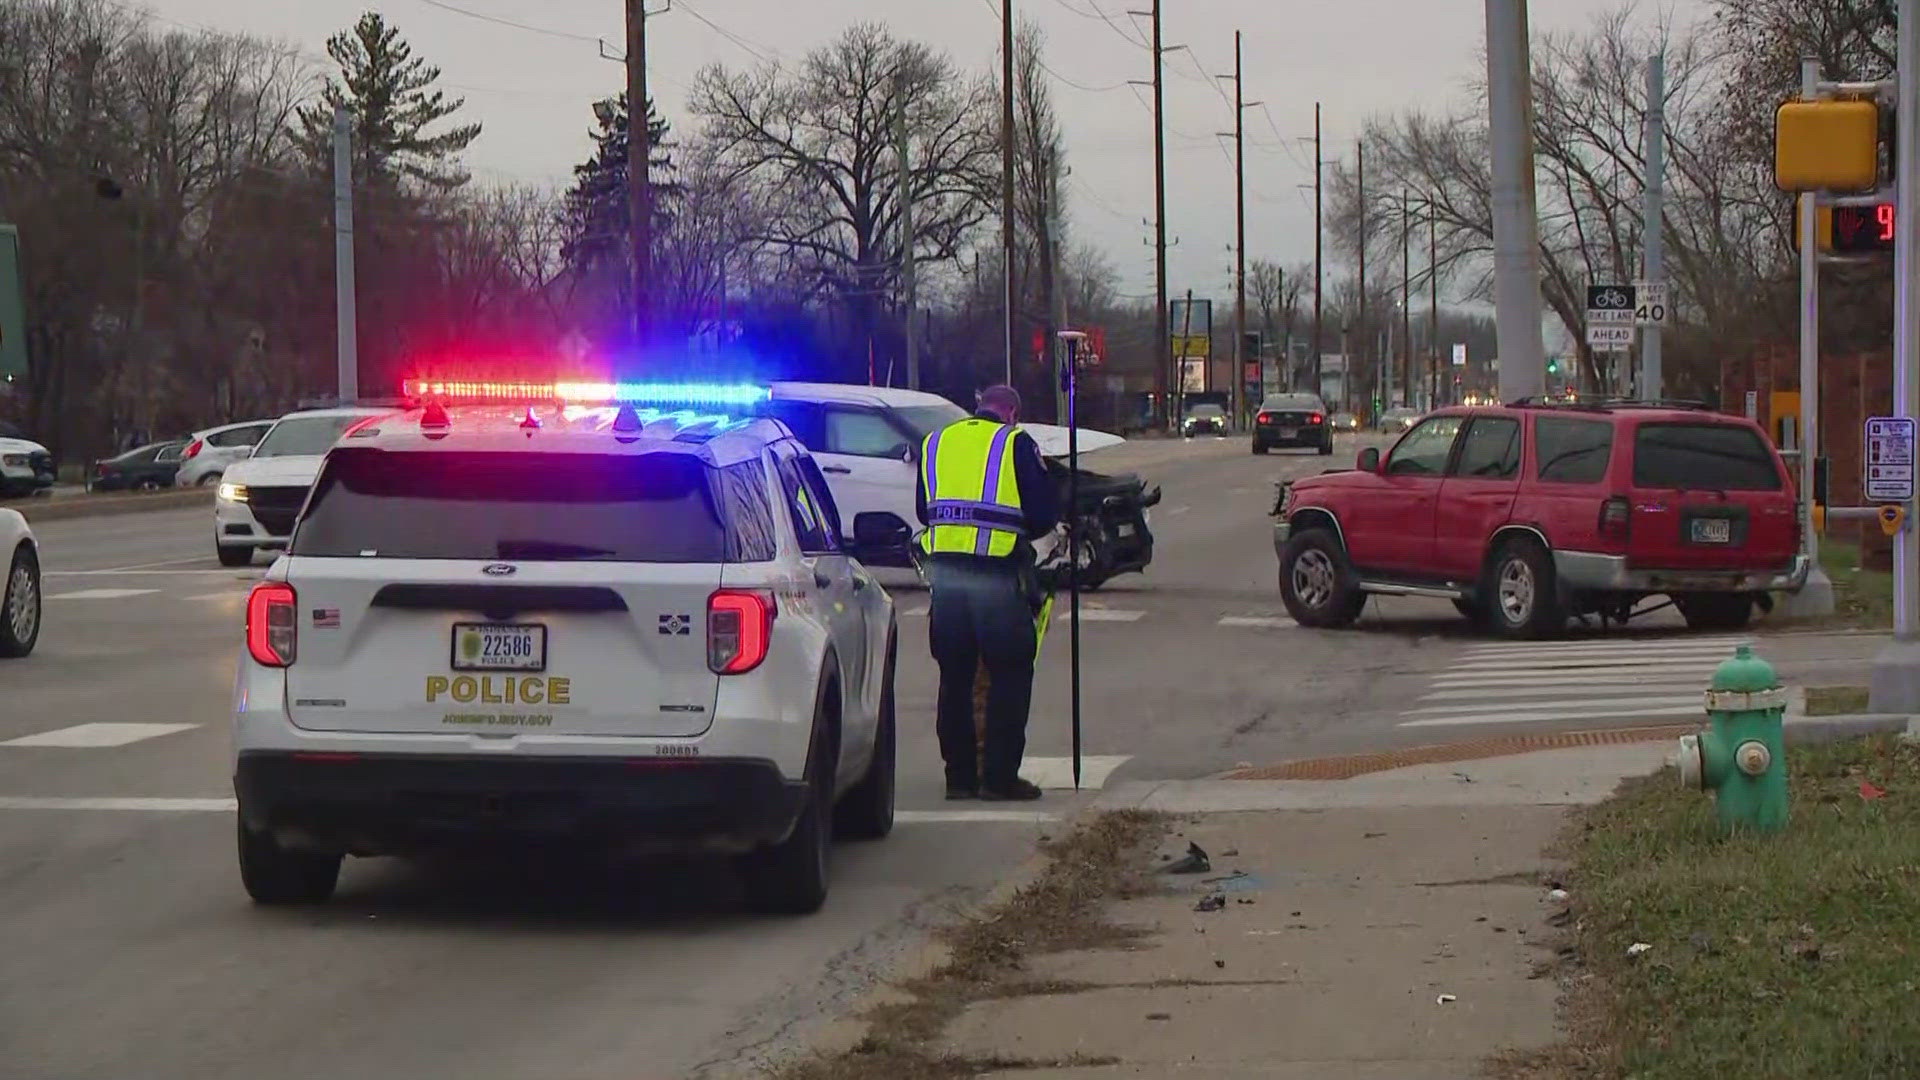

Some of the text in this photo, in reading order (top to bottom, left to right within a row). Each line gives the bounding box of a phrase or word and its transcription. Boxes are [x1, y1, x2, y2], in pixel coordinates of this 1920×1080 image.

[1877, 204, 1893, 240] 9
[1589, 311, 1632, 320] BIKE LANE
[1635, 305, 1664, 321] 40
[1593, 330, 1629, 340] AHEAD
[483, 635, 531, 657] 22586
[426, 675, 570, 704] POLICE
